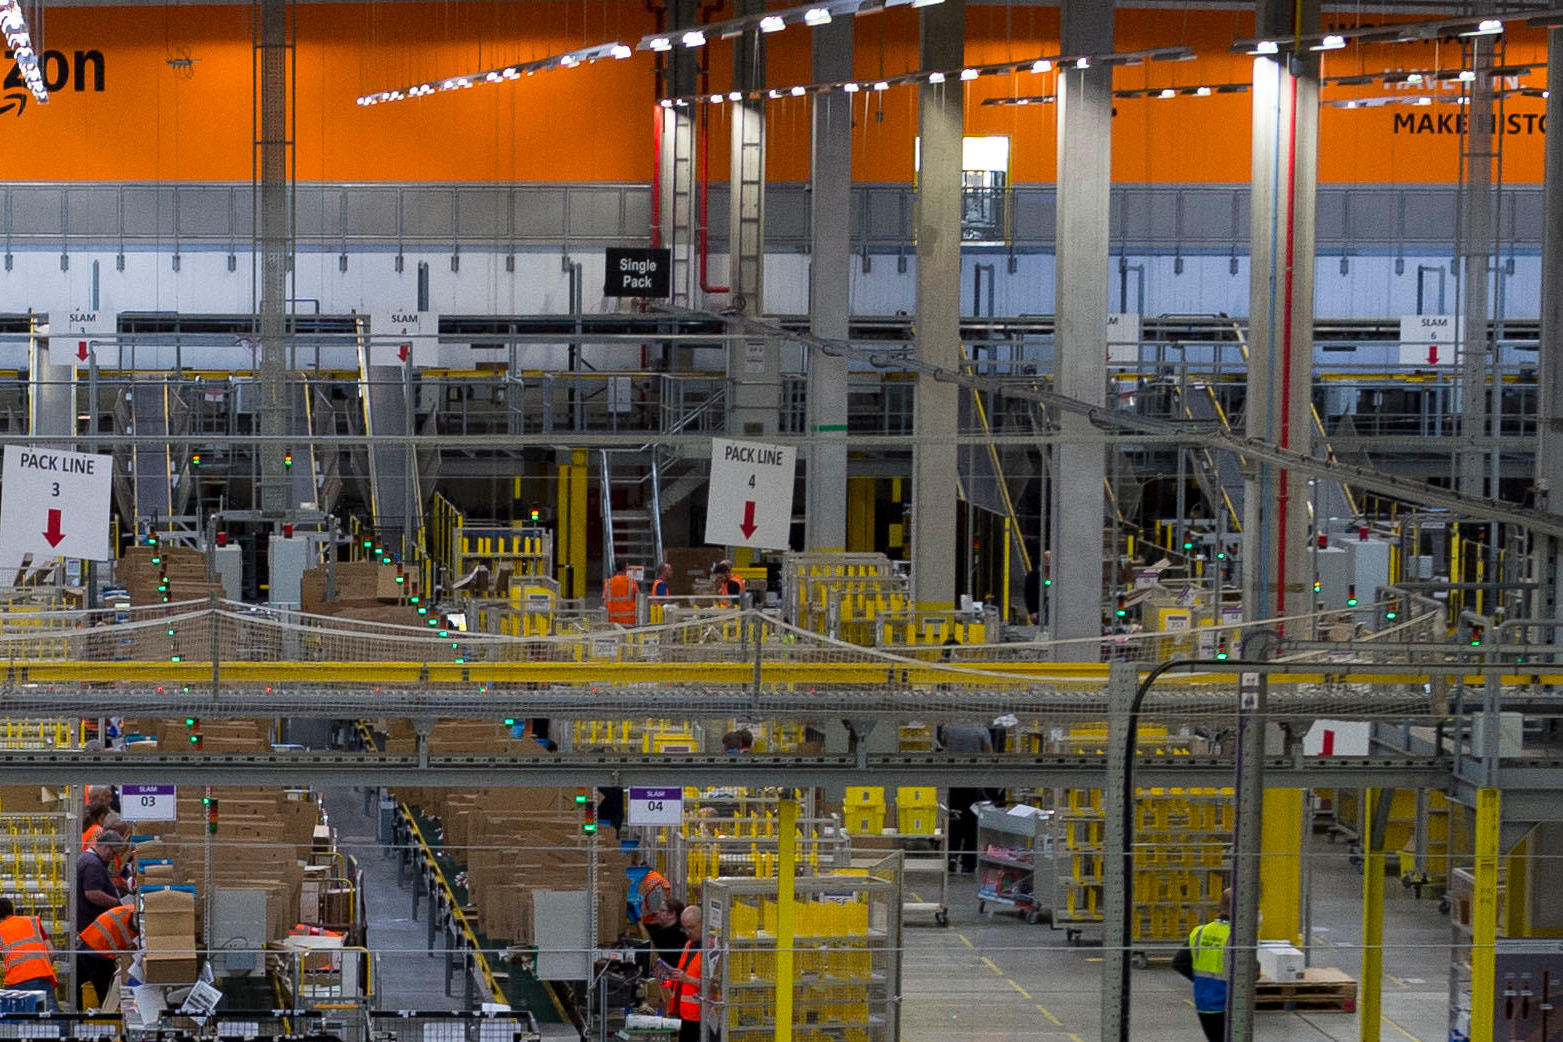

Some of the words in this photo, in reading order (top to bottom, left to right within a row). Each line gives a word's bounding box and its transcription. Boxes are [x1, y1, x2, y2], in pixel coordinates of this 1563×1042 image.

[1393, 113, 1468, 134] MAKE
[619, 258, 657, 274] Single
[623, 275, 652, 288] Pack
[69, 313, 97, 323] SLAM
[391, 314, 418, 323] SLAM
[1421, 318, 1448, 327] SLAM
[725, 445, 755, 463] PACK
[757, 448, 783, 466] LINE
[20, 453, 58, 471] PACK
[62, 457, 95, 475] LINE
[748, 473, 757, 489] 4
[51, 482, 60, 497] 3
[140, 796, 156, 807] 03
[648, 800, 663, 811] 04
